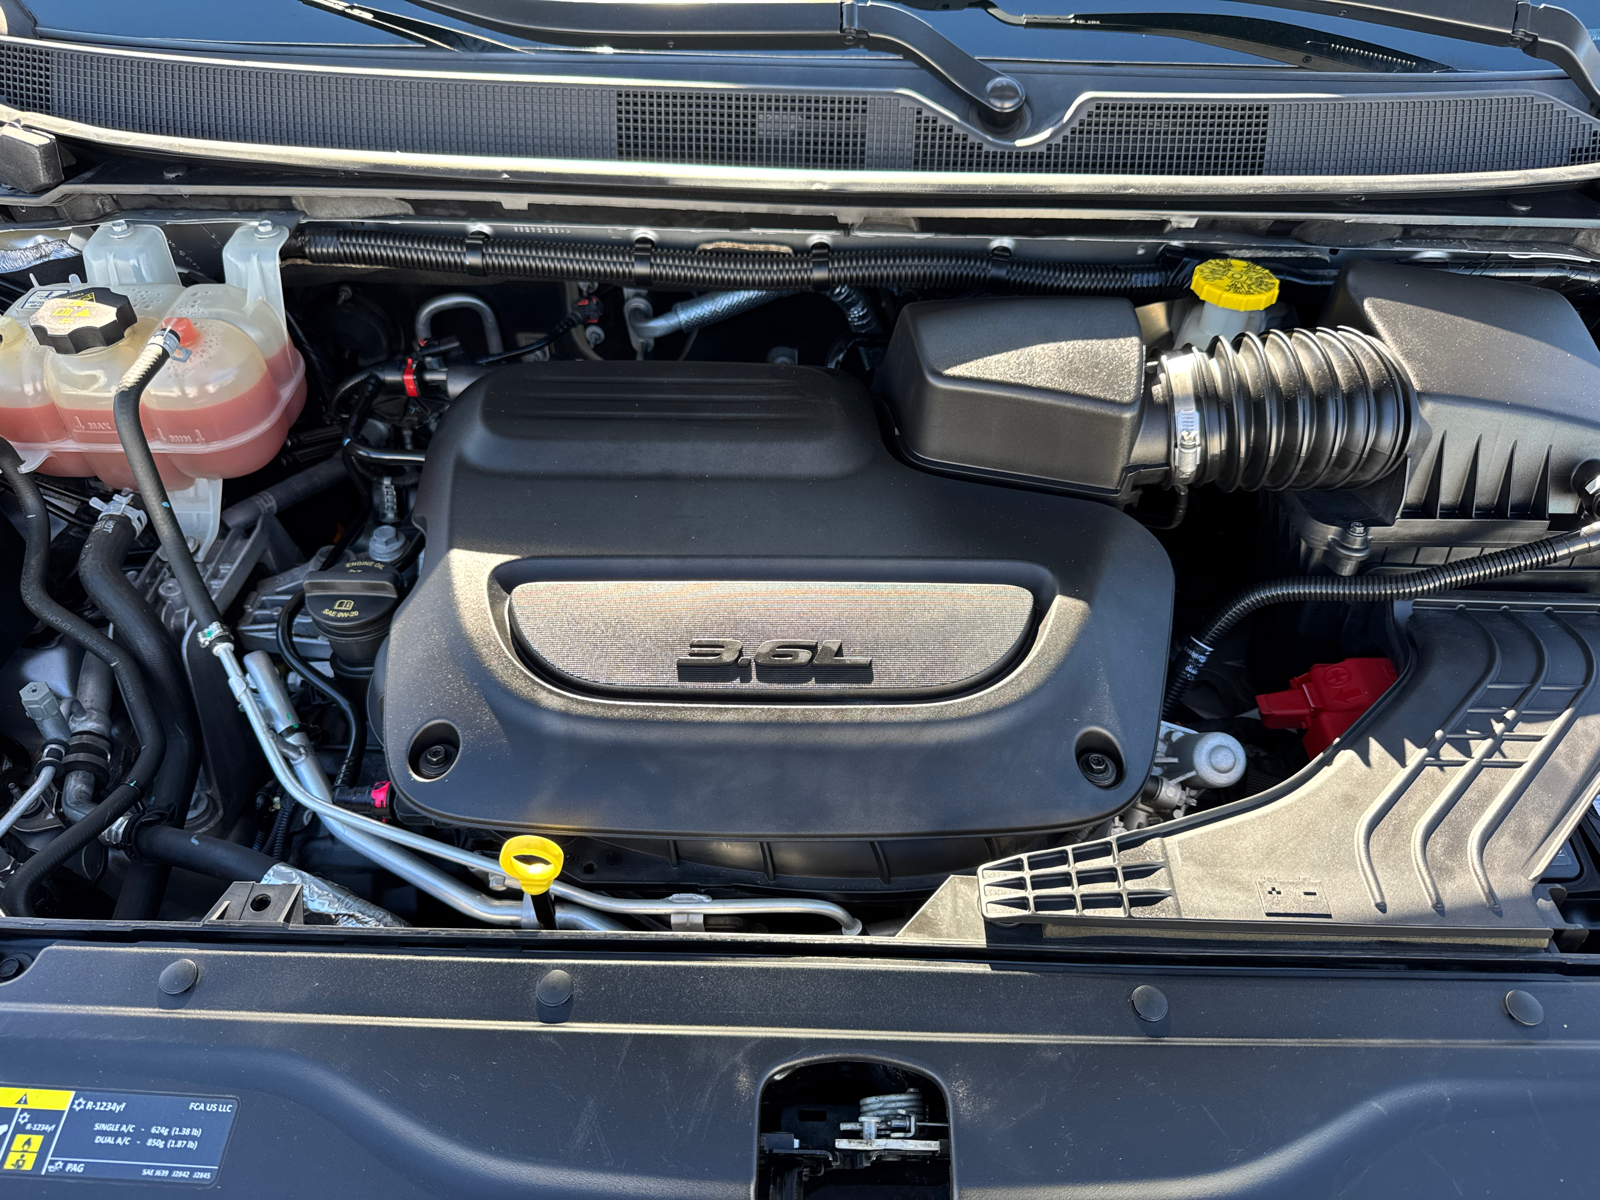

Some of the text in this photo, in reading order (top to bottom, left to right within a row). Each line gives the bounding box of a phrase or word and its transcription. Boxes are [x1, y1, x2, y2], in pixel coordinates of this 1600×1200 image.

[87, 422, 112, 430] MAX
[345, 560, 386, 570] ENGINE OIL
[322, 608, 360, 618] SAE 0W-20
[677, 638, 873, 668] 3.6L
[86, 1101, 127, 1113] R-1234yf
[188, 1102, 233, 1113] FCA US LLC
[25, 1123, 56, 1133] R-1234yf
[93, 1123, 121, 1132] SINGLE
[120, 1124, 136, 1133] A/C
[150, 1126, 169, 1136] 624g
[171, 1127, 191, 1136] (1.38
[191, 1128, 202, 1137] lb)
[94, 1136, 116, 1144] DUAL
[116, 1137, 131, 1145] A/C
[146, 1139, 165, 1148] 850g
[167, 1140, 187, 1149] (1.87
[187, 1141, 198, 1150] lb)
[65, 1163, 85, 1173] PAG
